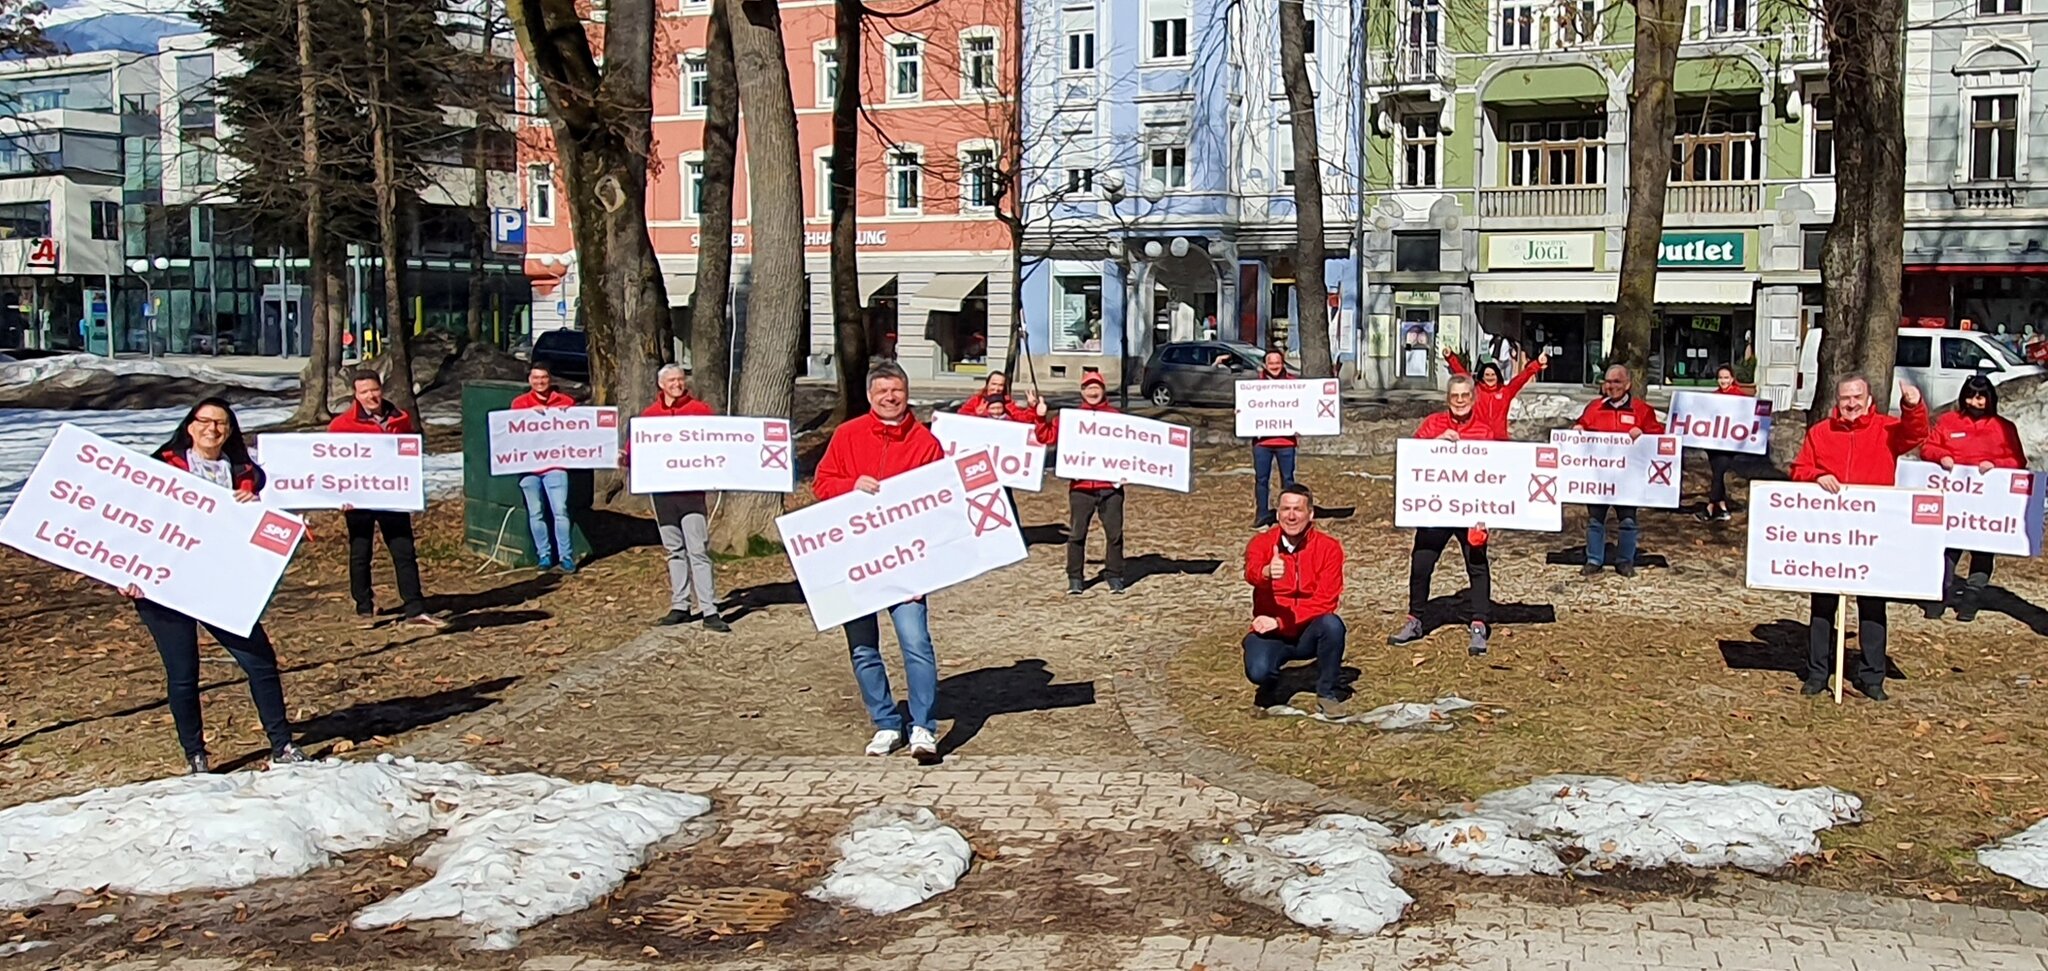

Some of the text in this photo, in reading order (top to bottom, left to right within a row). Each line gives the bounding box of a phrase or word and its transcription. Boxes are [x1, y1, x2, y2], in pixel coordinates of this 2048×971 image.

[497, 209, 522, 242] P
[1248, 398, 1299, 409] Gerhard
[508, 416, 590, 433] Machen
[1078, 420, 1162, 445] Machen
[1255, 419, 1293, 430] PIRIH
[1669, 412, 1760, 442] Hallo!
[635, 428, 755, 444] Ihre Stimme
[312, 442, 372, 459] Stolz
[495, 445, 603, 464] wir weiter!
[1462, 444, 1488, 456] das
[666, 455, 727, 469] auch?
[965, 460, 988, 478] SPÖ
[1063, 451, 1174, 478] wir weiter!
[1561, 454, 1626, 469] Gerhard
[76, 444, 216, 514] Schenken
[274, 474, 409, 494] auf Spittal!
[1411, 468, 1507, 485] TEAM der
[1927, 474, 1984, 495] Stolz
[1568, 481, 1615, 496] PIRIH
[1402, 494, 1516, 516] SPÖ Spittal
[1769, 492, 1876, 513] Schenken
[1916, 502, 1940, 514] SPÖ
[50, 480, 201, 552] Sie uns Ihr
[790, 487, 953, 557] Ihre Stimme
[1946, 512, 2017, 534] pittal!
[262, 523, 293, 540] SPÖ
[1765, 526, 1879, 547] Sie uns Ihr
[35, 520, 171, 585] Lächeln?
[848, 539, 927, 582] auch?
[1771, 559, 1870, 580] Lächeln?
